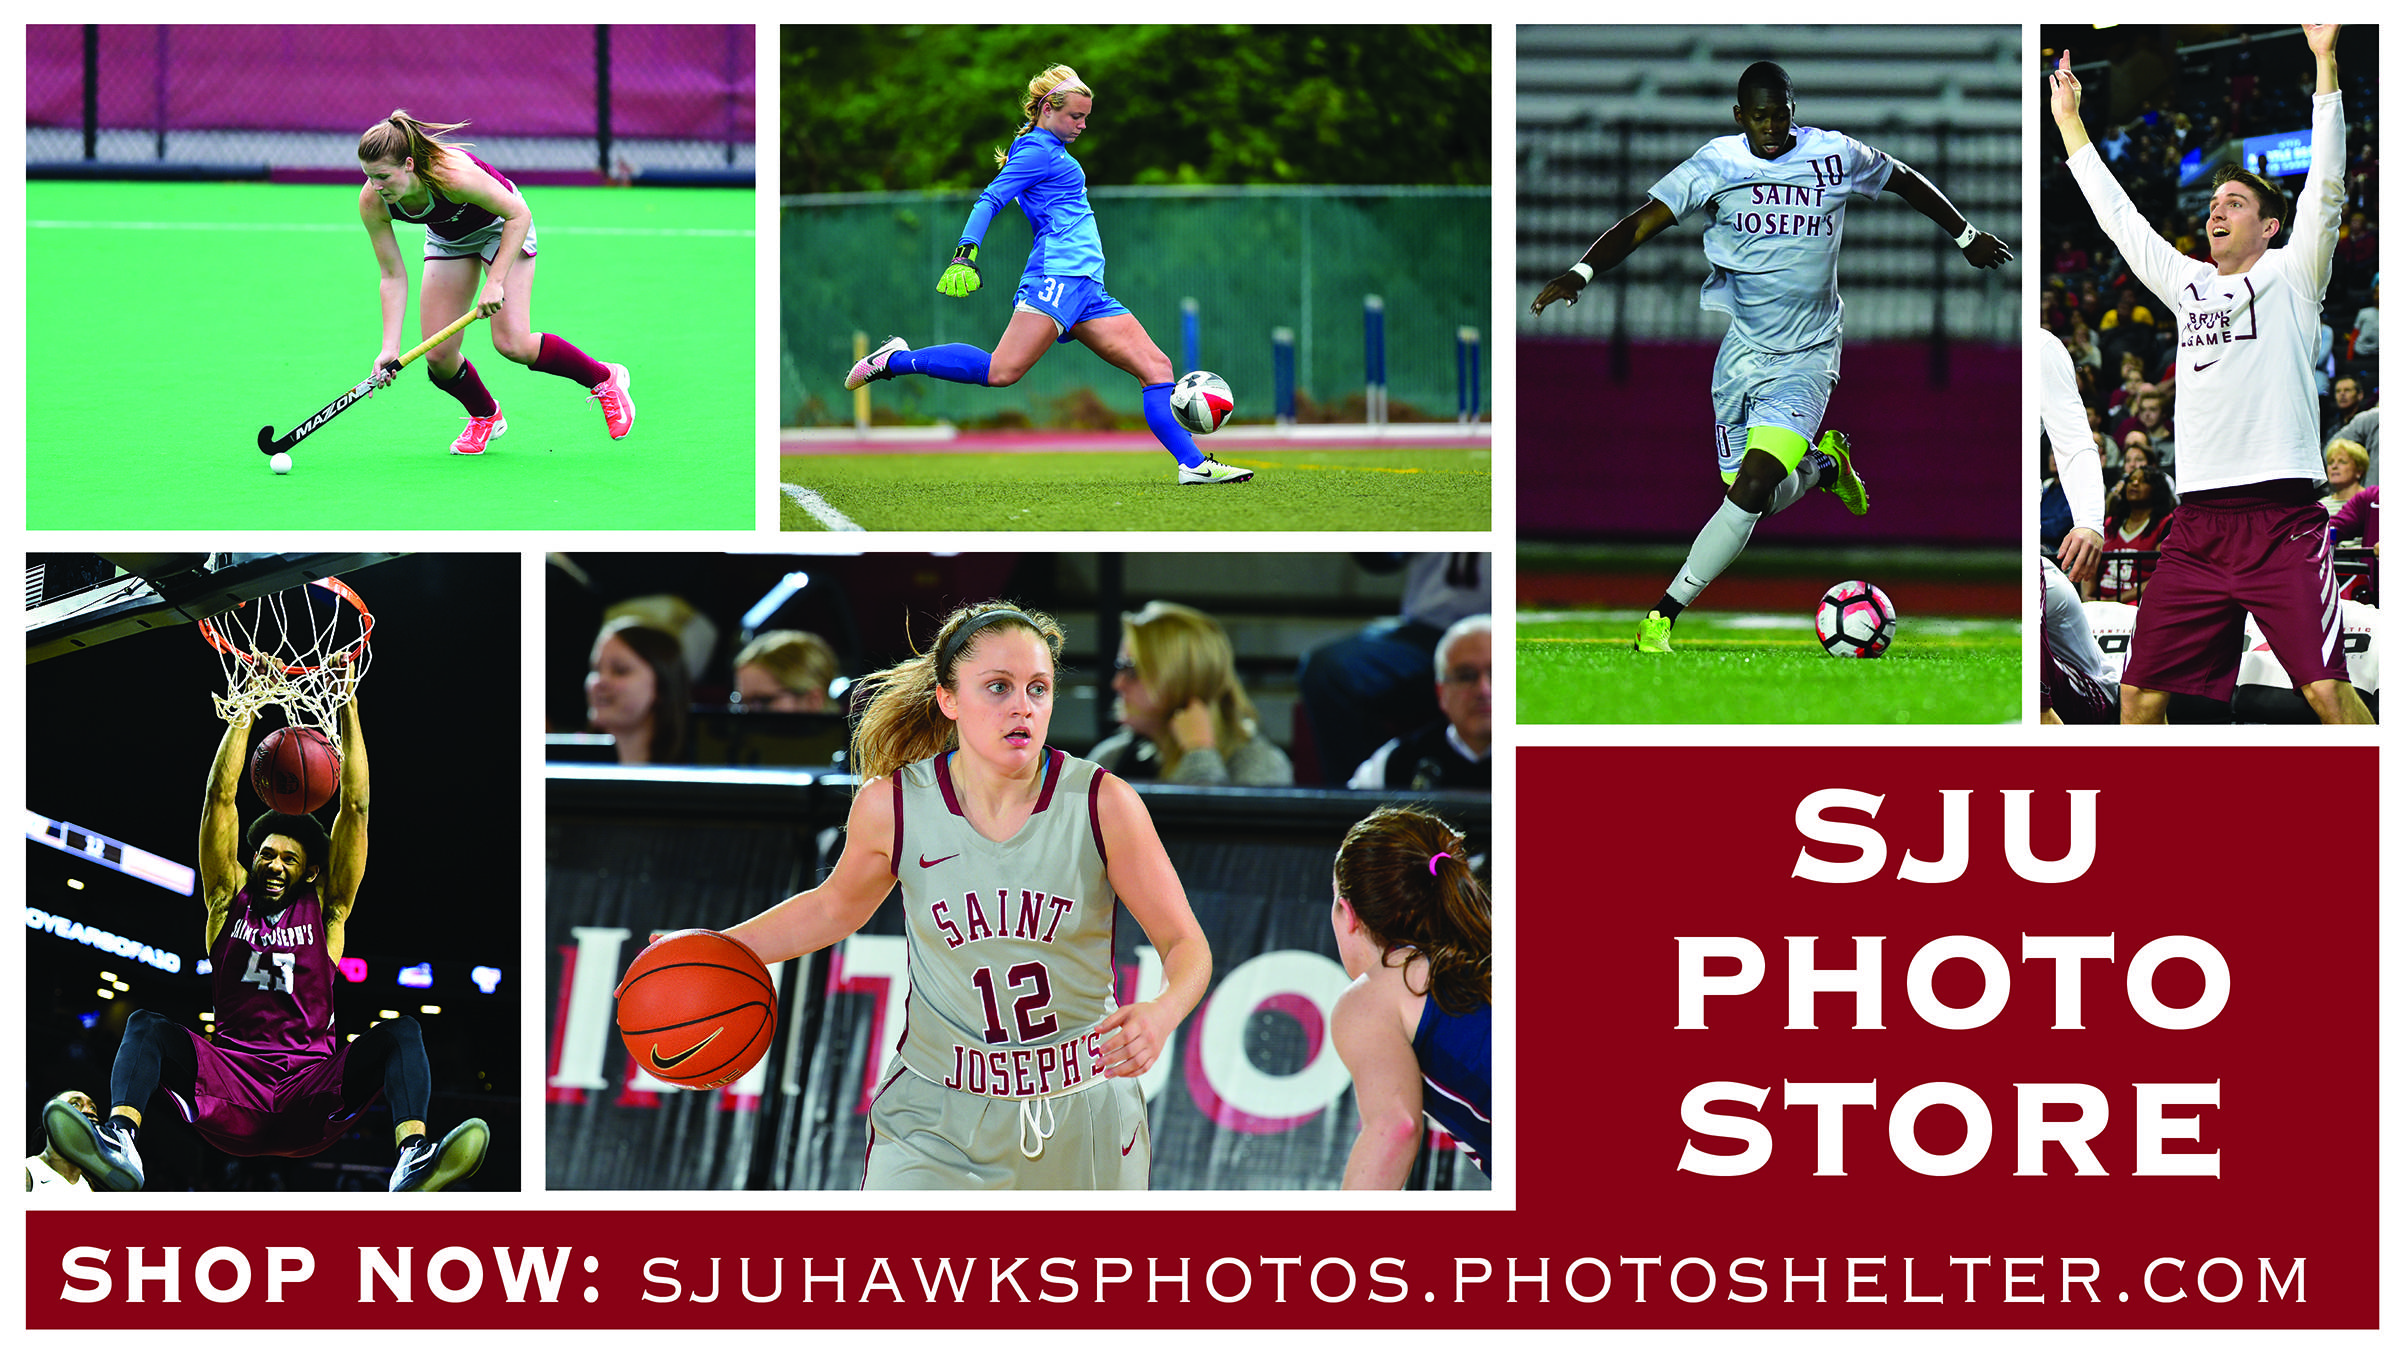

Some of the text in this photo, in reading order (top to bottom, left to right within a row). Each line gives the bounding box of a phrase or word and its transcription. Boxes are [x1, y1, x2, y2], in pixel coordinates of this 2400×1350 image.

[1807, 154, 1844, 188] 10
[1752, 184, 1825, 207] SAINT
[1733, 212, 1833, 237] JOSEPH'S
[1037, 277, 1065, 308] 31
[2188, 309, 2232, 324] BRIN
[2187, 331, 2232, 347] GAME
[931, 888, 1074, 949] SAINT
[240, 951, 295, 994] 43
[971, 960, 1059, 1044] 12
[945, 1031, 1106, 1097] JOSEPH'S
